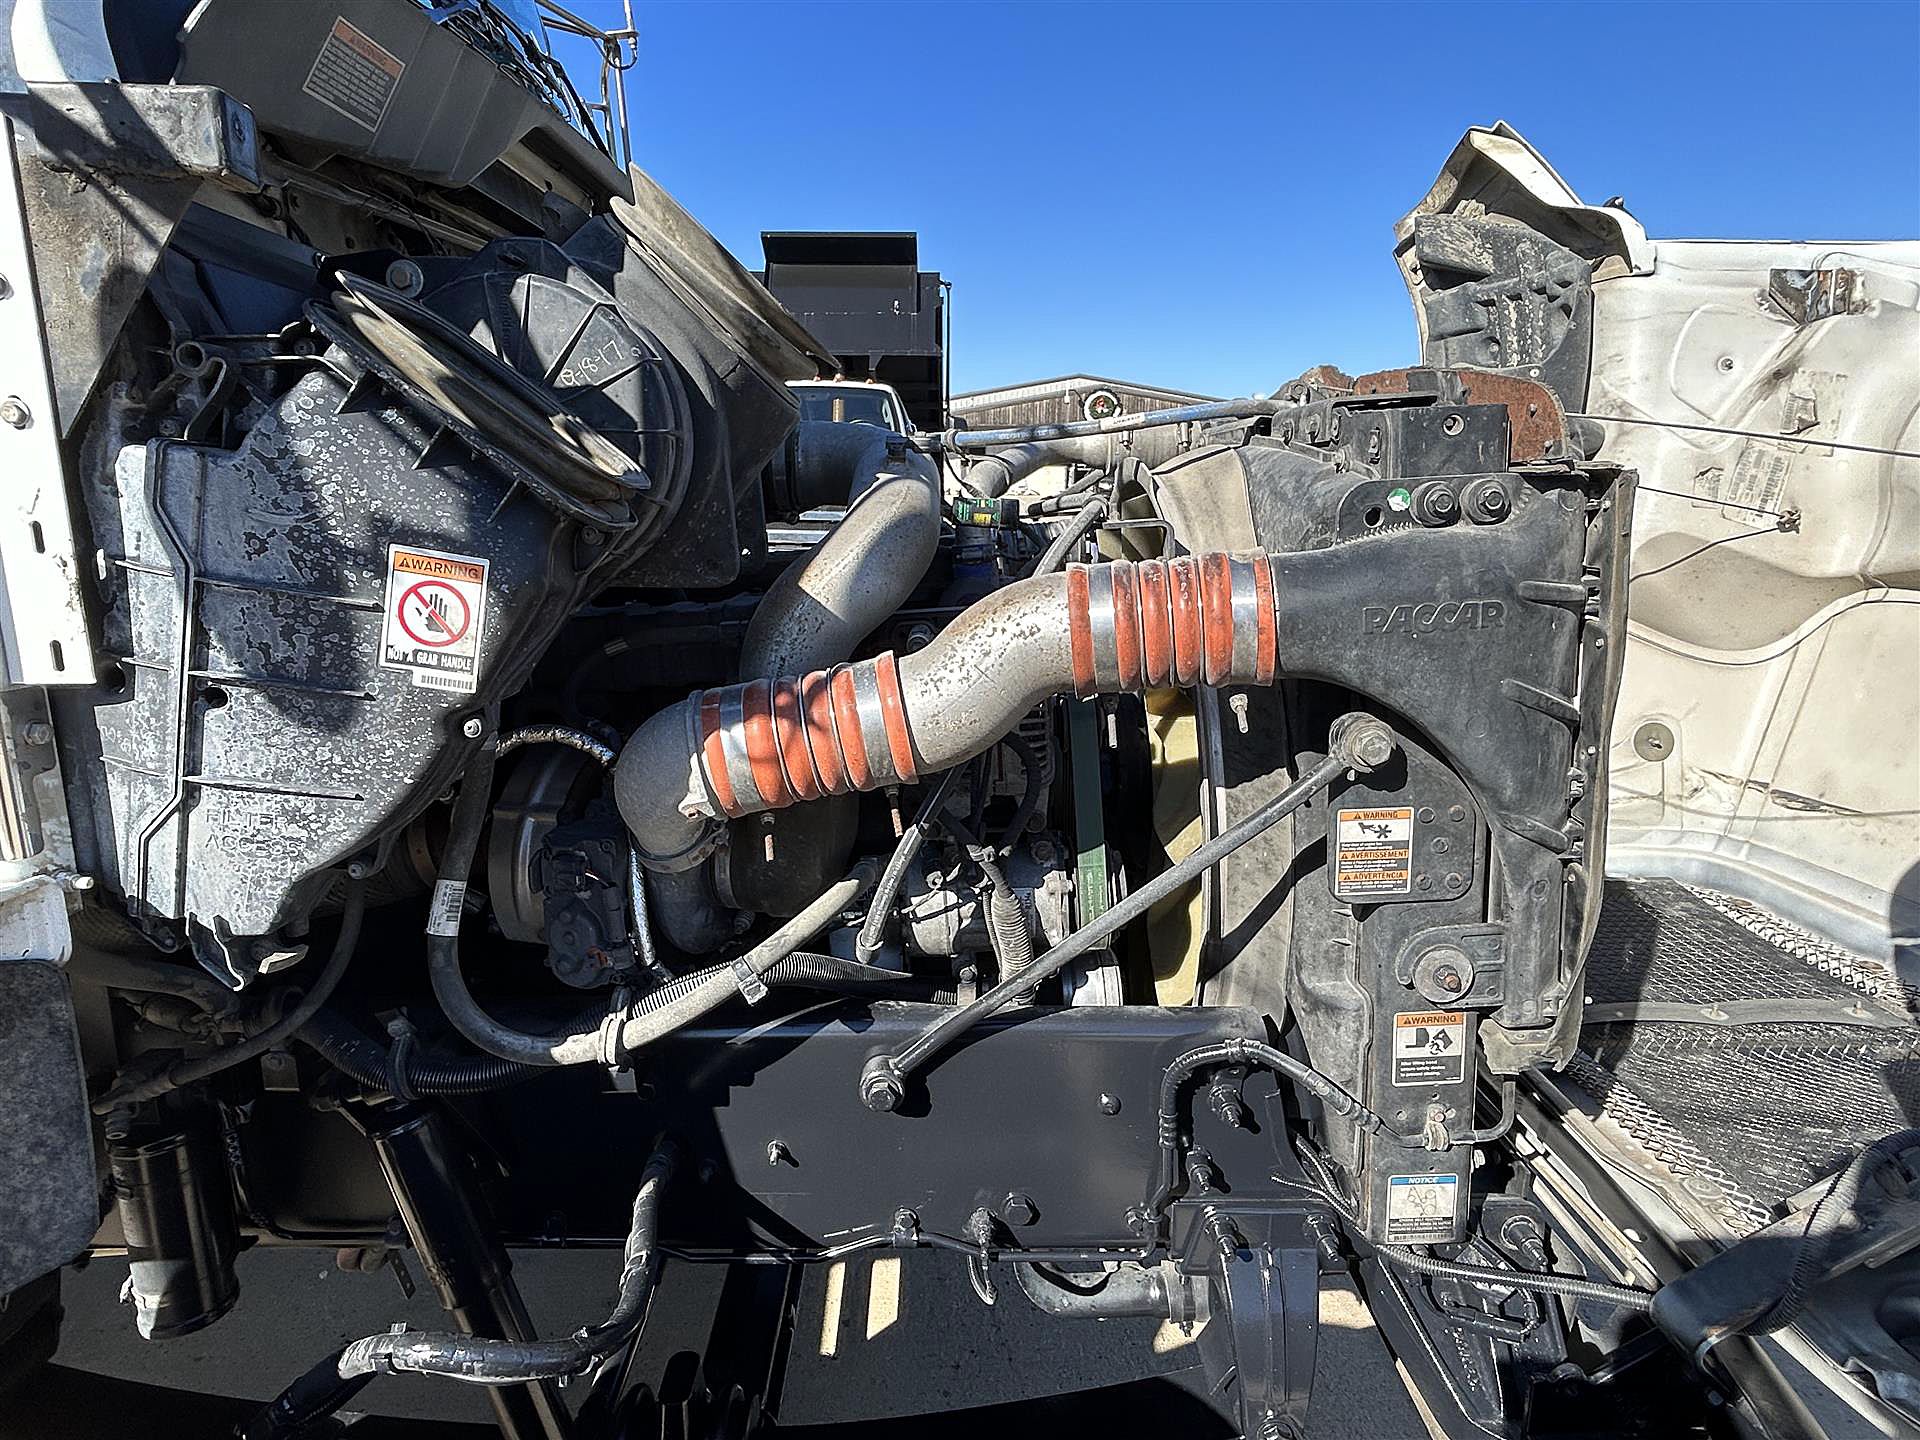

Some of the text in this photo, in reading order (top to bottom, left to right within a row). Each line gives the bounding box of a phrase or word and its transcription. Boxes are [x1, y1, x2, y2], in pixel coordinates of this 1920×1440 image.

[411, 558, 480, 580] WARNING
[1362, 599, 1507, 635] PACCAR
[387, 647, 473, 671] NOT A GRAB HANDLE
[1350, 850, 1407, 859] AVERTISSEMENT
[1411, 1015, 1457, 1025] WARNING
[1408, 1176, 1439, 1184] NOTICE
